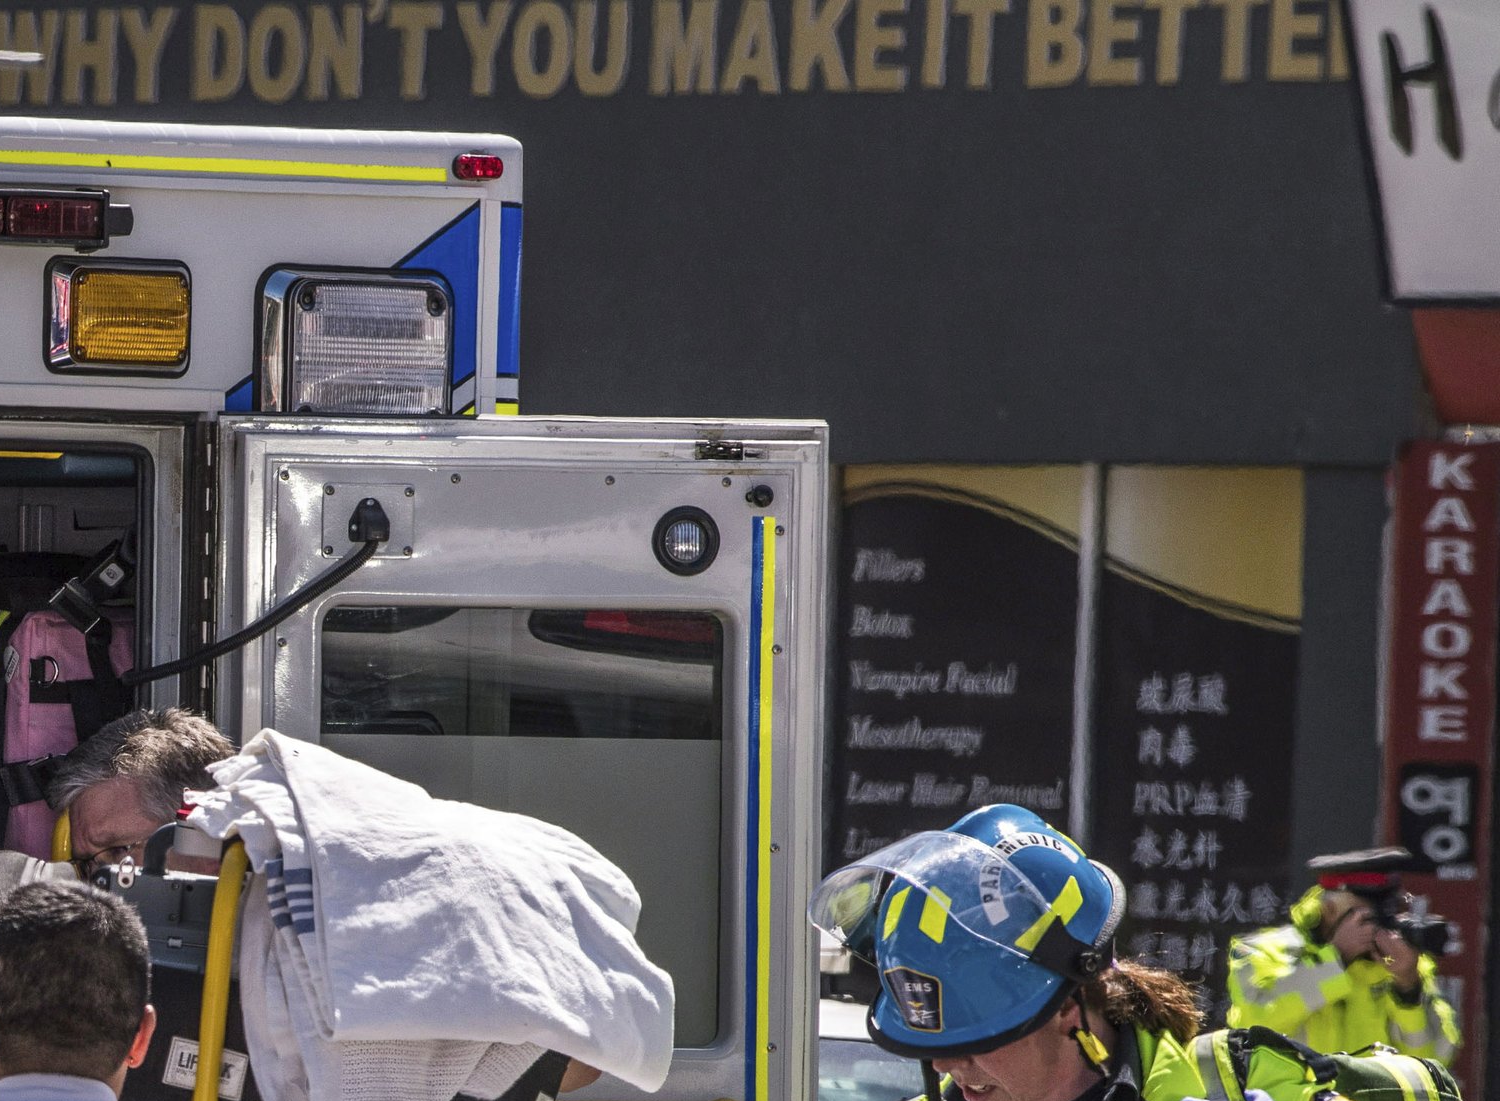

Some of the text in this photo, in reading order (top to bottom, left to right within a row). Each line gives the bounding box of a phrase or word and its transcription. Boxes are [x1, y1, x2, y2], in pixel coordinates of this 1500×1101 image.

[194, 0, 443, 100] DON'T
[458, 0, 631, 97] YOU
[649, 0, 905, 93] MAKE
[922, 0, 1002, 88] IT
[1379, 3, 1500, 162] H
[1417, 451, 1478, 742] KARAOKE
[904, 982, 933, 992] EMS
